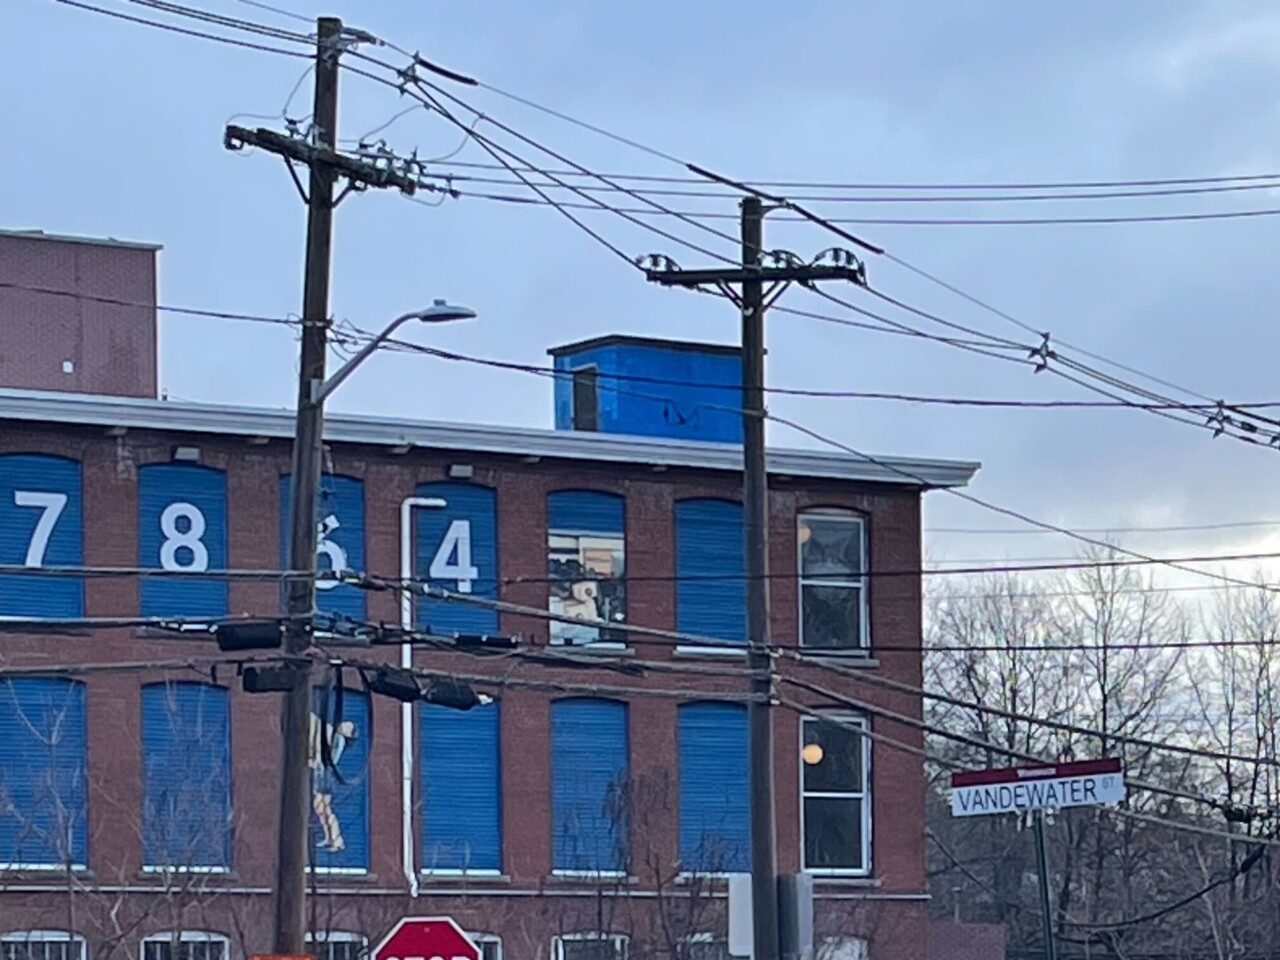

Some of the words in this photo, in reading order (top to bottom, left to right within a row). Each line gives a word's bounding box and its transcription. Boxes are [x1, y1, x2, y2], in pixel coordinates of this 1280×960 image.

[14, 490, 68, 568] 7
[160, 502, 208, 573] 8
[429, 520, 478, 593] 4
[957, 778, 1098, 812] VANDEWATER
